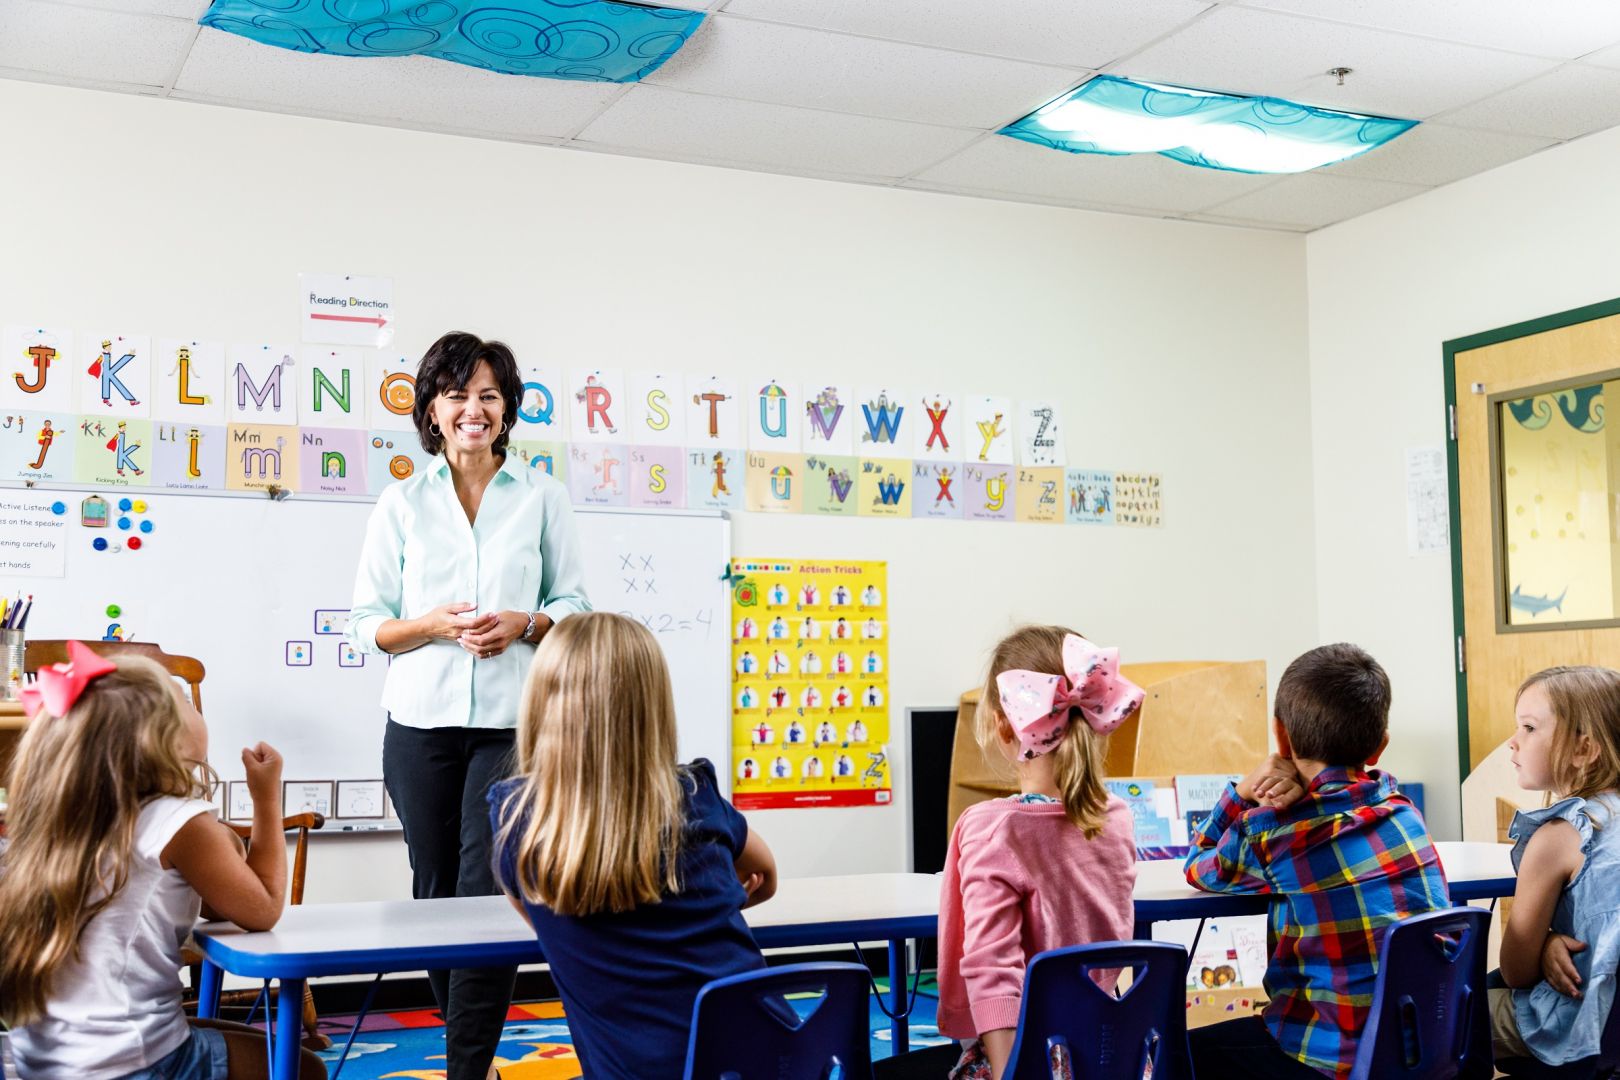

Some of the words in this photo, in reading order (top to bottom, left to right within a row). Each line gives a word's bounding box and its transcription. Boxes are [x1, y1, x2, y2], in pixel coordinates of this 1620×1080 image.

[310, 292, 347, 307] Reading
[349, 297, 389, 309] Direction
[15, 346, 56, 394] J
[101, 352, 137, 402] K
[179, 358, 205, 406] L
[237, 363, 282, 409] M
[313, 367, 351, 413] N
[517, 382, 554, 426] Q
[585, 386, 614, 428] R
[646, 389, 670, 431] S
[701, 393, 725, 434] T
[861, 404, 904, 444] W
[926, 408, 950, 448] X
[20, 518, 33, 526] the
[34, 520, 65, 528] speaker
[23, 504, 52, 512] Listene
[8, 561, 31, 569] hands
[22, 541, 56, 550] carefully
[799, 565, 832, 574] Action
[834, 565, 863, 575] Tricks
